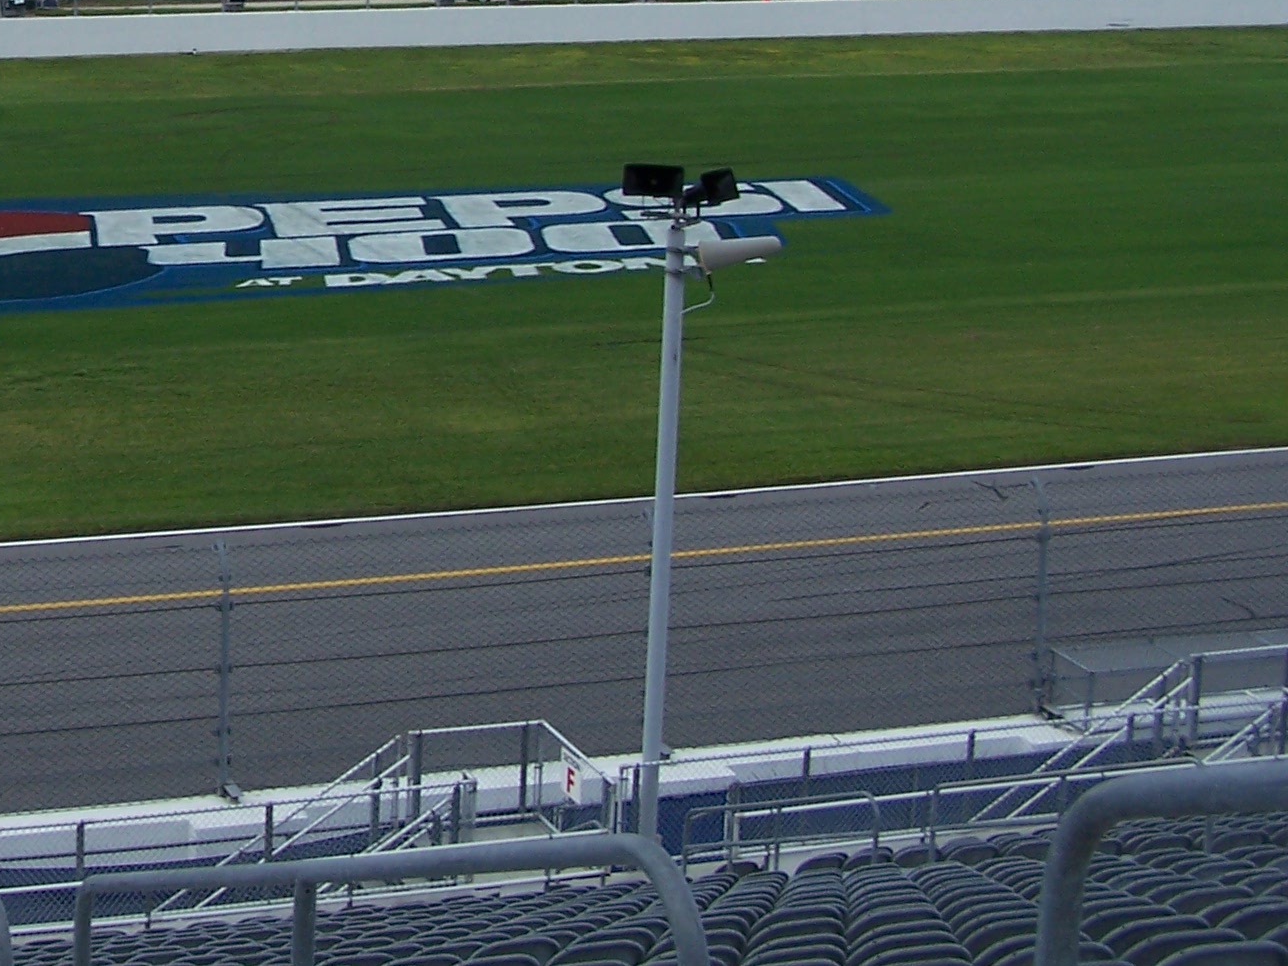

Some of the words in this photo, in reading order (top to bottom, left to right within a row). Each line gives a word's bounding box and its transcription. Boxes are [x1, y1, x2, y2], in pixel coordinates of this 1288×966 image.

[235, 276, 303, 288] AT
[323, 256, 767, 287] DAYTON
[567, 766, 575, 793] F
